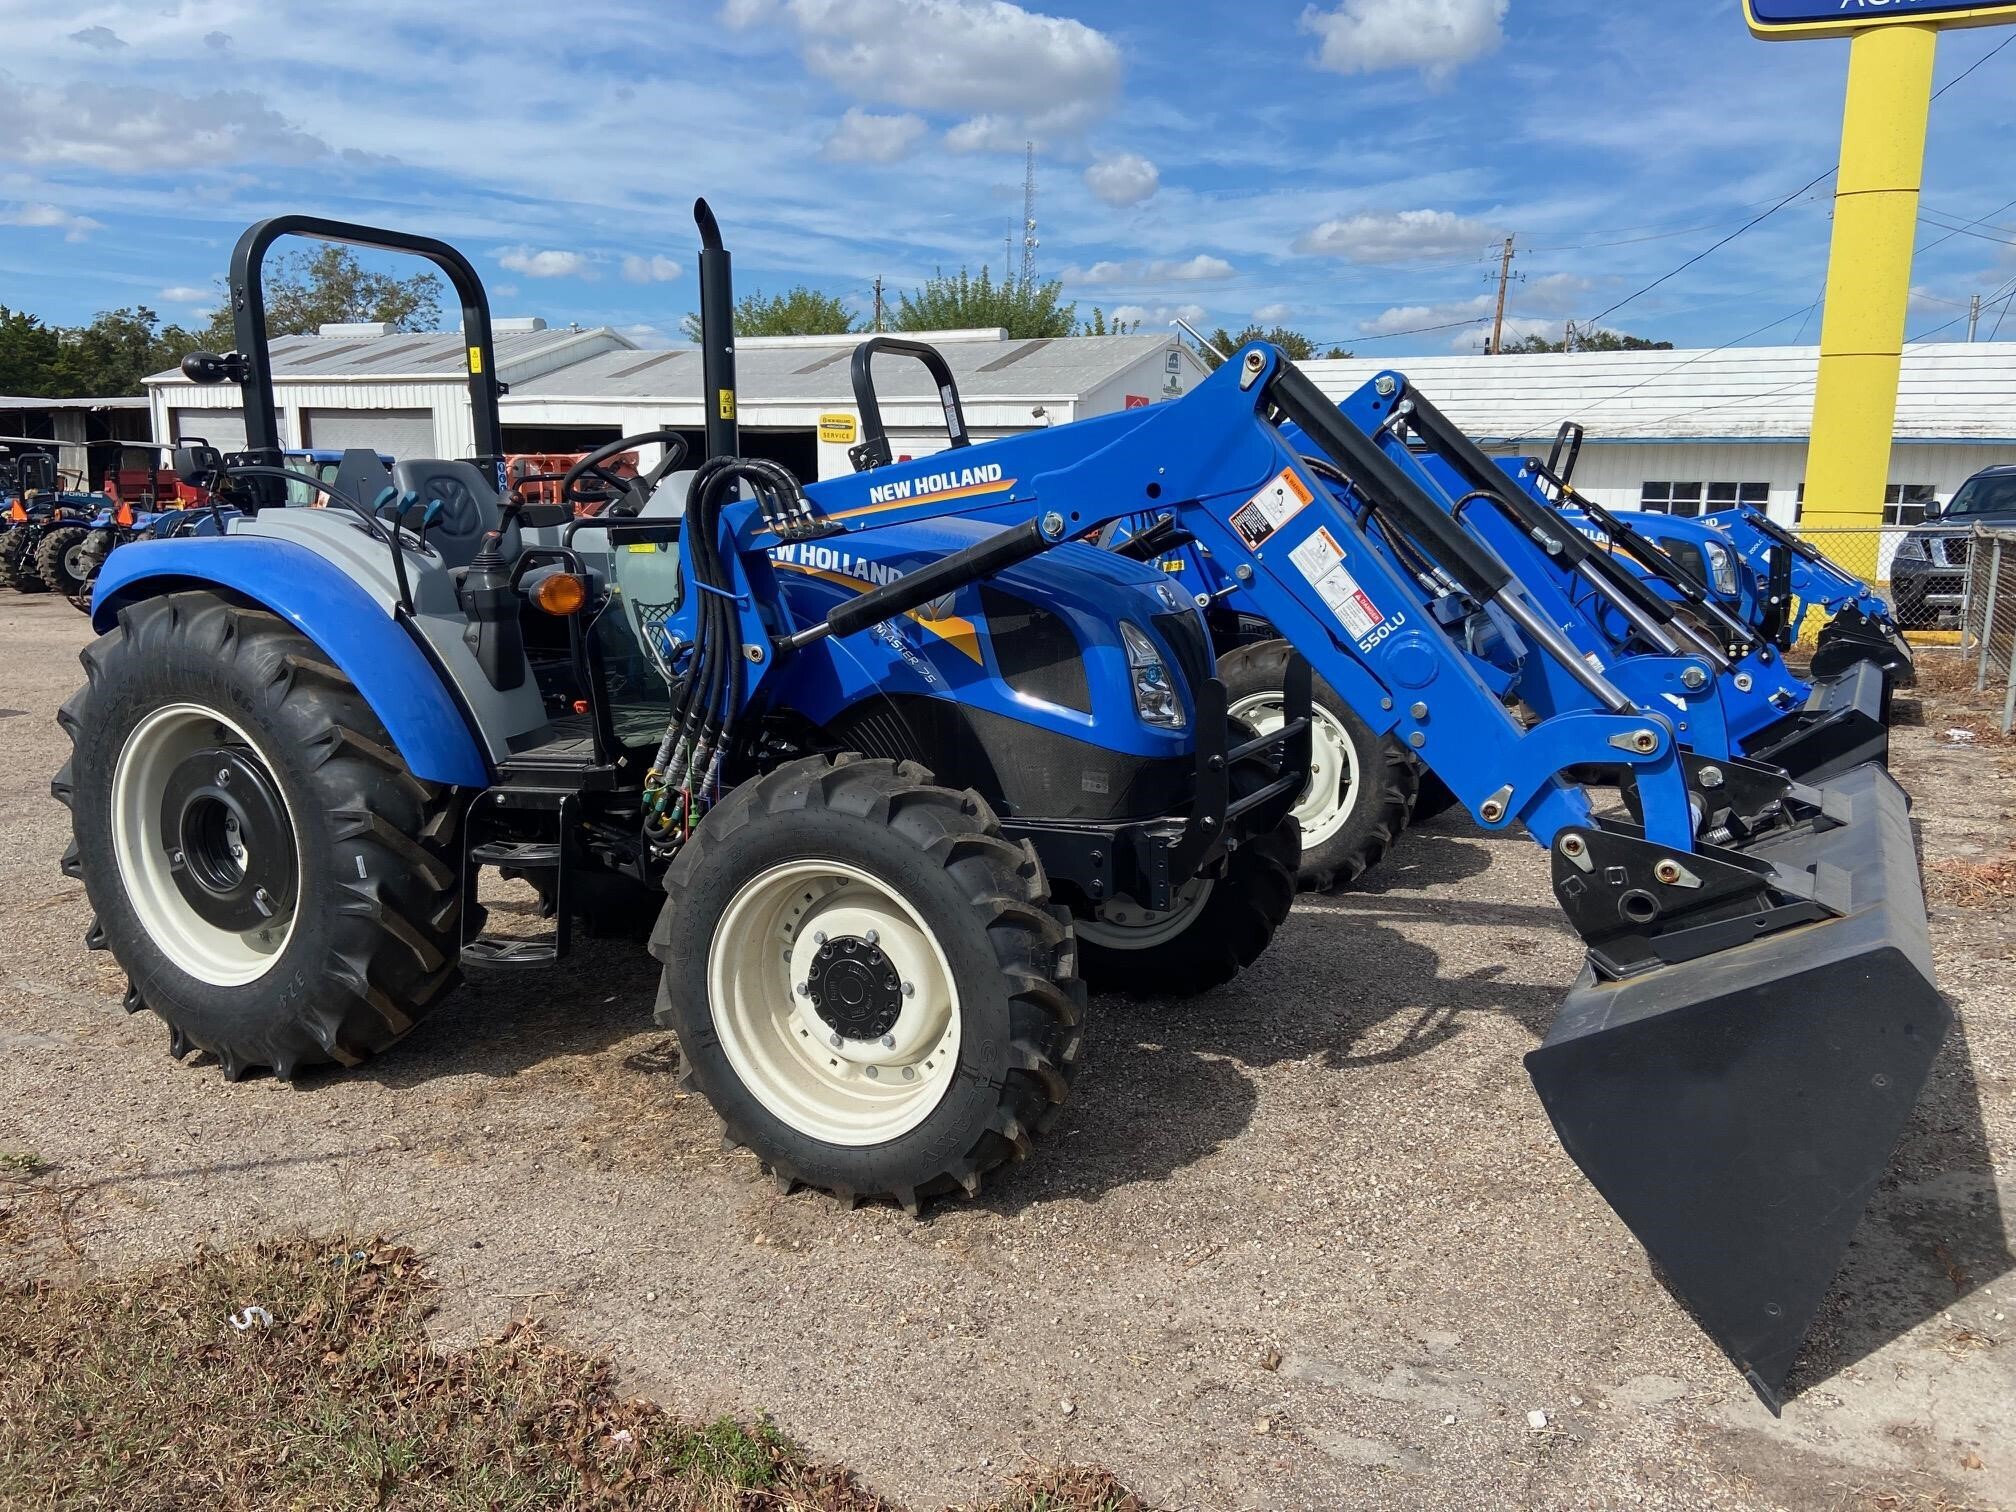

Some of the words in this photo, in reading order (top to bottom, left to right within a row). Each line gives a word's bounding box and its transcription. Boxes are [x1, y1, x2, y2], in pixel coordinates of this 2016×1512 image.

[869, 480, 911, 504] NEW
[914, 463, 1002, 495] HOLLAND
[799, 543, 904, 586] HOLLAND
[1359, 598, 1380, 621] DANGER
[872, 622, 919, 667] MASTER
[917, 667, 937, 684] 75
[1358, 611, 1406, 654] 550LU
